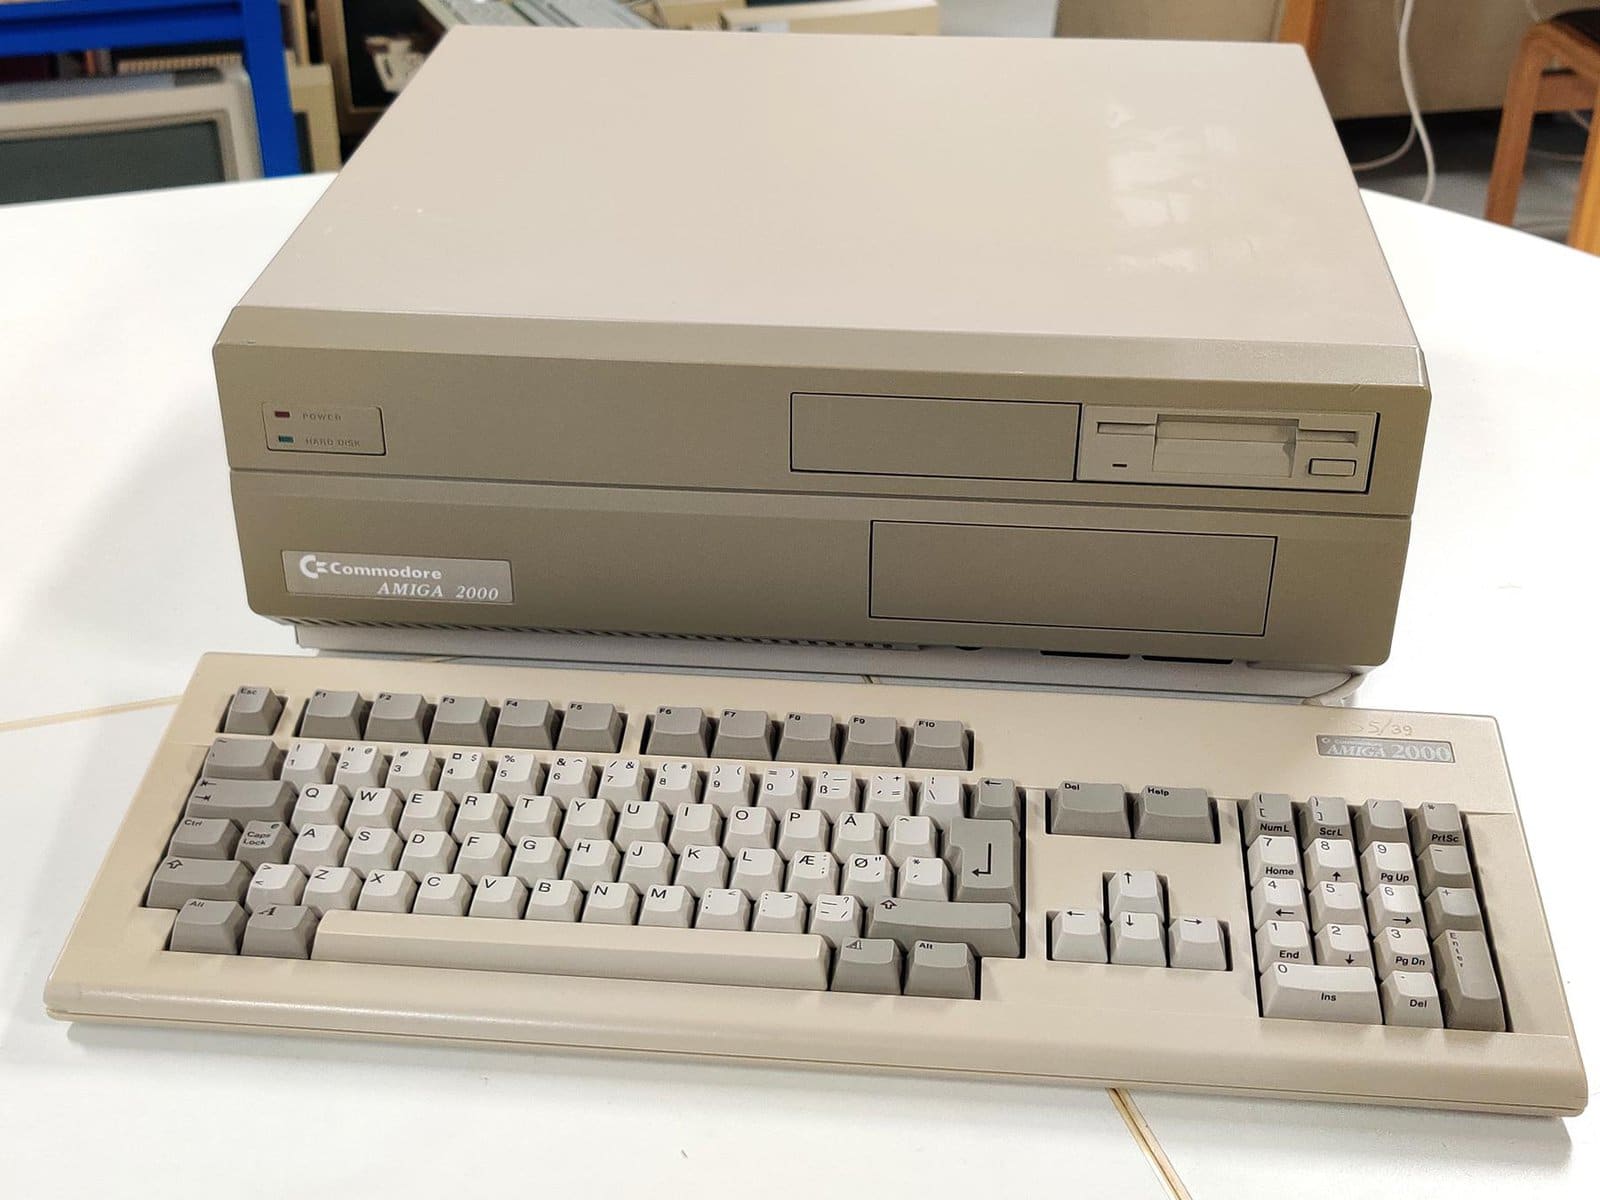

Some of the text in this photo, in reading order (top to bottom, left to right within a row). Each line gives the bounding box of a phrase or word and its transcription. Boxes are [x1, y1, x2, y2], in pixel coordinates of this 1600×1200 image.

[302, 412, 341, 420] POWER
[338, 439, 360, 448] DISK
[330, 562, 442, 580] Commodore
[376, 582, 499, 600] AMIGA 2000
[240, 687, 258, 696] Esc
[506, 700, 519, 708] F4
[853, 717, 866, 725] F9
[918, 720, 936, 728] F10
[1327, 744, 1452, 761] AMIGA 2000
[1064, 782, 1080, 791] Del
[305, 787, 320, 799] Q
[360, 790, 378, 802] W
[1147, 787, 1170, 797] Help
[411, 793, 424, 804] E
[464, 796, 478, 806] R
[522, 798, 534, 808] T
[574, 801, 586, 812] Y
[627, 804, 640, 814] U
[736, 810, 749, 820] O
[790, 812, 801, 822] P
[184, 819, 202, 827] Ctrl
[247, 831, 272, 840] Caps
[303, 828, 316, 838] A
[358, 831, 371, 842] S
[243, 838, 266, 846] Lock
[412, 834, 425, 844] D
[467, 836, 480, 847] F
[1263, 837, 1272, 846] 7
[1431, 834, 1460, 844] PrtSc
[523, 840, 536, 850] G
[576, 842, 591, 853] H
[1320, 841, 1330, 851] 8
[1377, 844, 1387, 854] 9
[632, 846, 643, 857] J
[688, 848, 700, 859] K
[742, 852, 752, 862] L
[798, 855, 816, 866] Æ
[854, 857, 868, 868] Ø
[314, 870, 329, 880] Z
[1265, 866, 1294, 876] Home
[370, 874, 386, 884] X
[428, 876, 441, 887] C
[1380, 872, 1410, 882] Pg Up
[484, 878, 497, 889] V
[538, 882, 552, 893] B
[1267, 880, 1277, 890] 4
[1326, 884, 1336, 893] 5
[594, 886, 609, 896] N
[650, 888, 667, 899] M
[1384, 887, 1394, 896] 6
[1272, 922, 1278, 932] 1
[1331, 926, 1342, 936] 2
[1391, 929, 1402, 939] 3
[918, 942, 934, 950] Alt
[1279, 950, 1300, 960] End
[1395, 956, 1426, 967] Pg Dn
[1278, 964, 1288, 974] 0
[1320, 992, 1337, 1002] Ins
[1410, 999, 1428, 1008] Del
